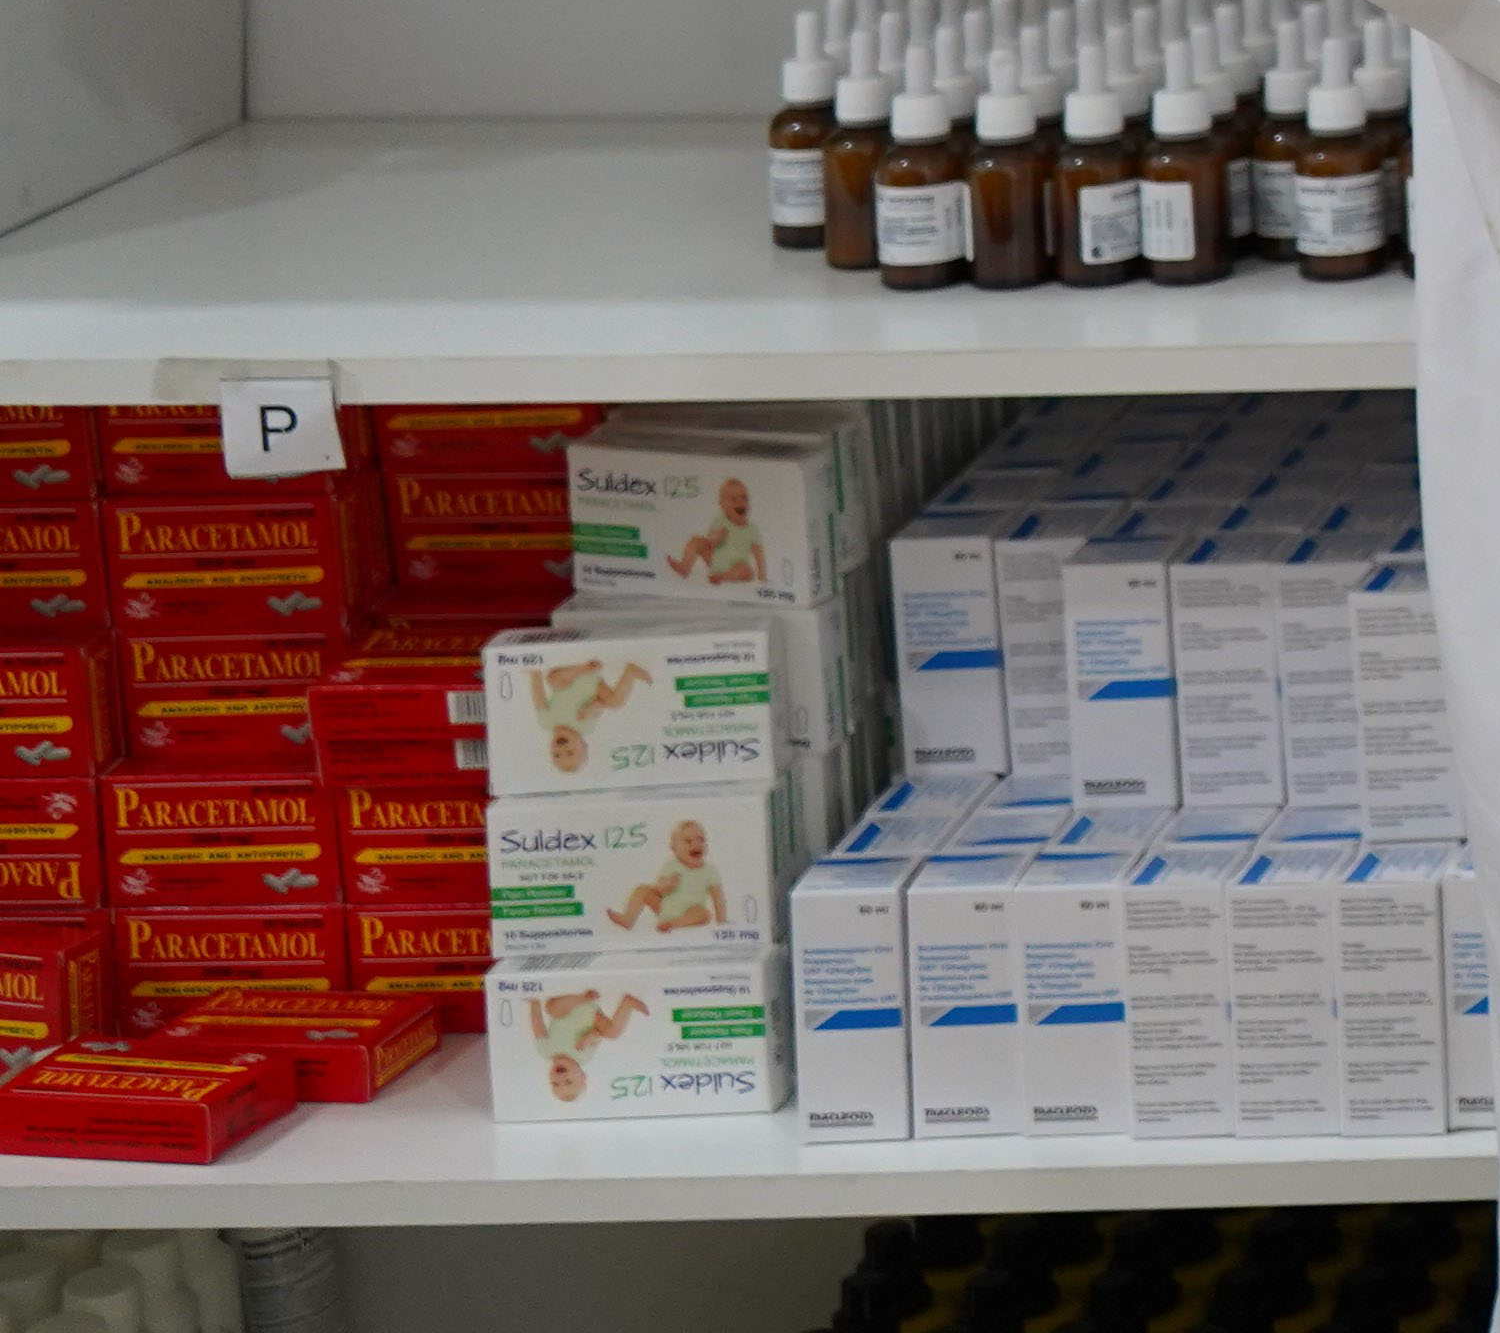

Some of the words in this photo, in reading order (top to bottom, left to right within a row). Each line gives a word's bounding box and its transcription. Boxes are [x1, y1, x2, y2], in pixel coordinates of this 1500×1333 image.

[259, 405, 298, 452] P
[576, 468, 658, 497] Suldex
[116, 509, 318, 554] PARACETAMOL
[663, 737, 761, 763] Suldex
[115, 787, 316, 829] PARACETAMOL
[499, 828, 596, 854] Suldex
[604, 824, 648, 849] 125
[128, 919, 326, 960] PARACETAMOL
